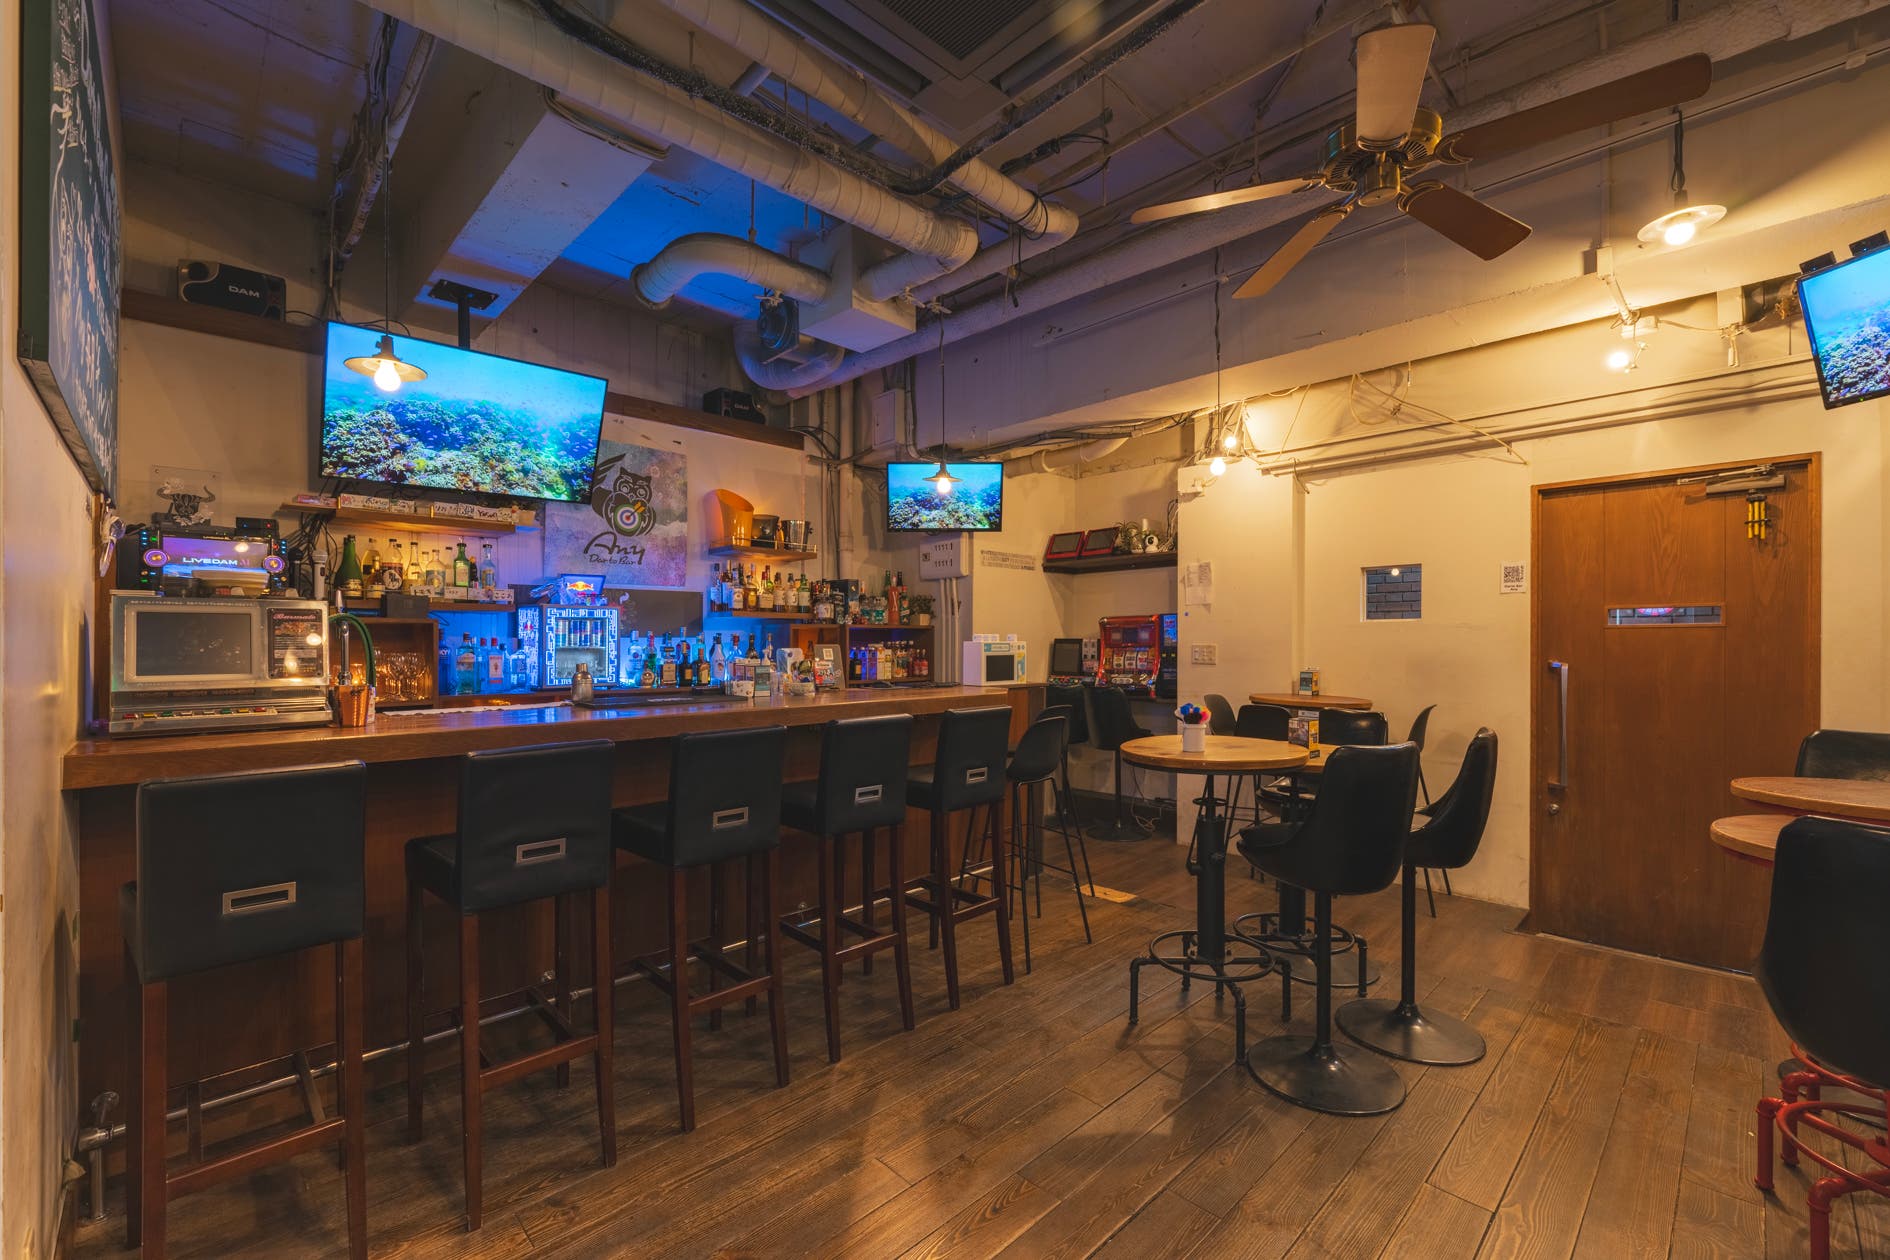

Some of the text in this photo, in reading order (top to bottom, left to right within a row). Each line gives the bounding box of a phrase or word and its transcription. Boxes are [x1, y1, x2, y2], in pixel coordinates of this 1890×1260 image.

[228, 285, 260, 298] DAM
[583, 531, 646, 565] Any
[182, 556, 238, 566] LIVEDAM
[619, 555, 636, 565] Bar
